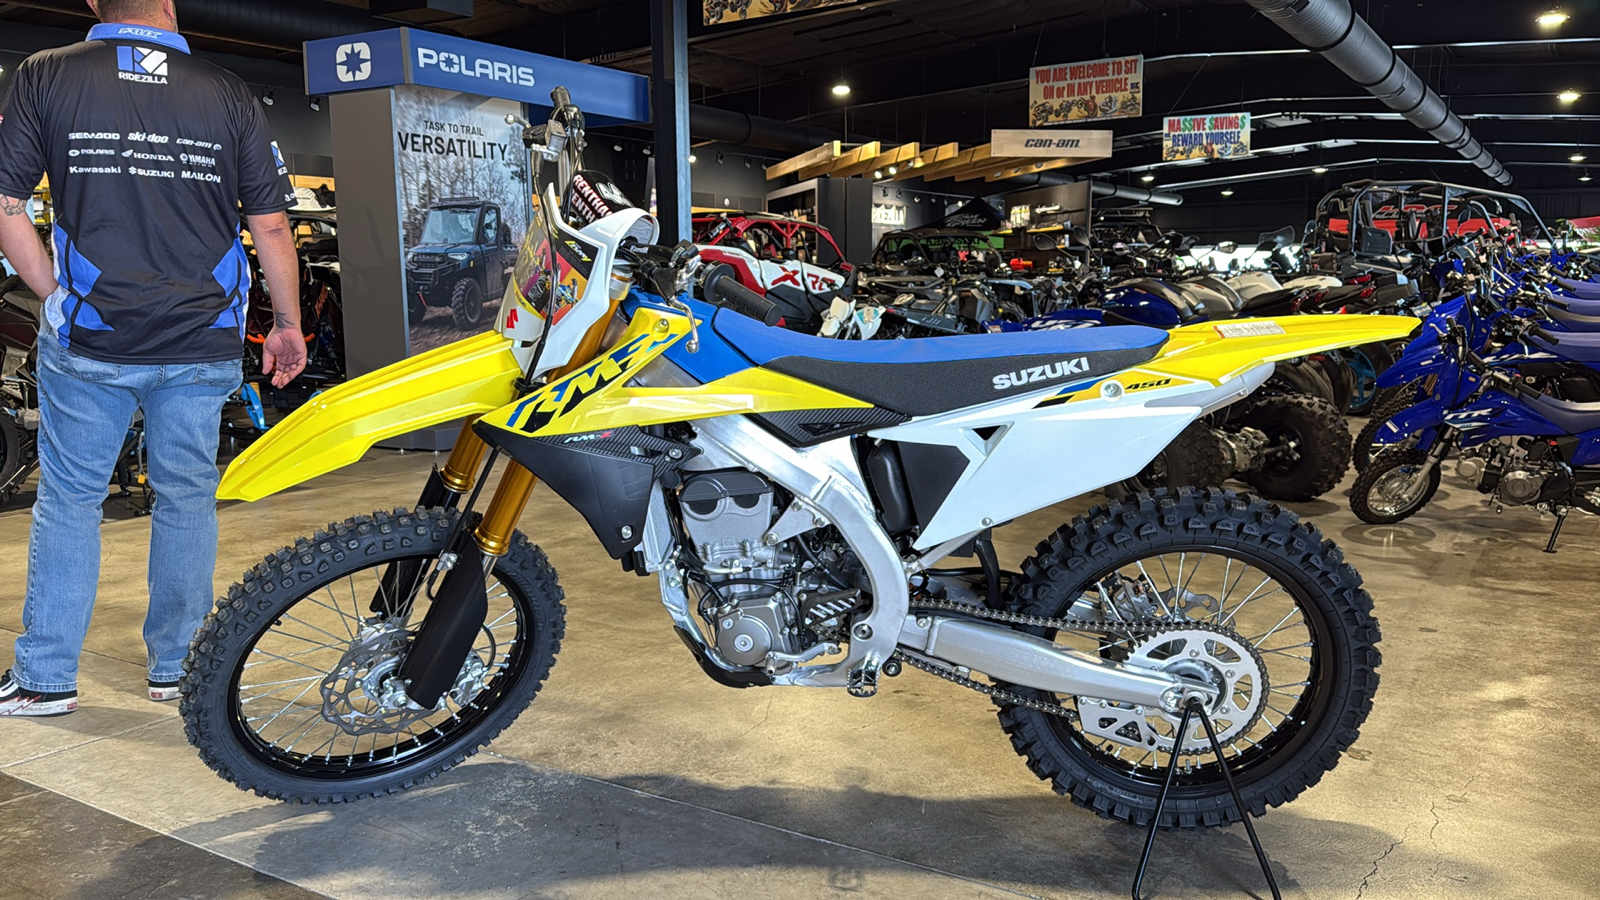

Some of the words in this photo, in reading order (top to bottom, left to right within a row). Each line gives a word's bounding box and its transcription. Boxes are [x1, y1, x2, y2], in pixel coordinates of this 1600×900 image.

[417, 47, 535, 87] POLARIS
[1035, 69, 1051, 84] YOU
[1052, 67, 1068, 82] ARE
[1069, 62, 1109, 80] WELCOME
[1111, 60, 1122, 76] TO
[1124, 59, 1139, 74] SIT
[118, 71, 168, 84] RIDEZILLA
[1043, 85, 1054, 100] ON
[1067, 83, 1075, 97] IN
[1077, 81, 1093, 96] ANY
[1095, 77, 1128, 94] VEHICLE
[424, 120, 446, 132] TASK
[448, 123, 459, 133] TO
[460, 125, 484, 136] TRAIL
[397, 132, 507, 160] VERSATILITY
[1024, 138, 1080, 148] can-am
[1172, 133, 1203, 147] REWARD
[1205, 131, 1241, 145] YOURSELF
[133, 152, 175, 162] HONDA
[69, 166, 121, 174] Kawasaki
[137, 168, 175, 178] SUZUKI
[572, 188, 597, 224] ENTH
[992, 356, 1090, 390] SUZUKI
[1125, 378, 1172, 390] 450
